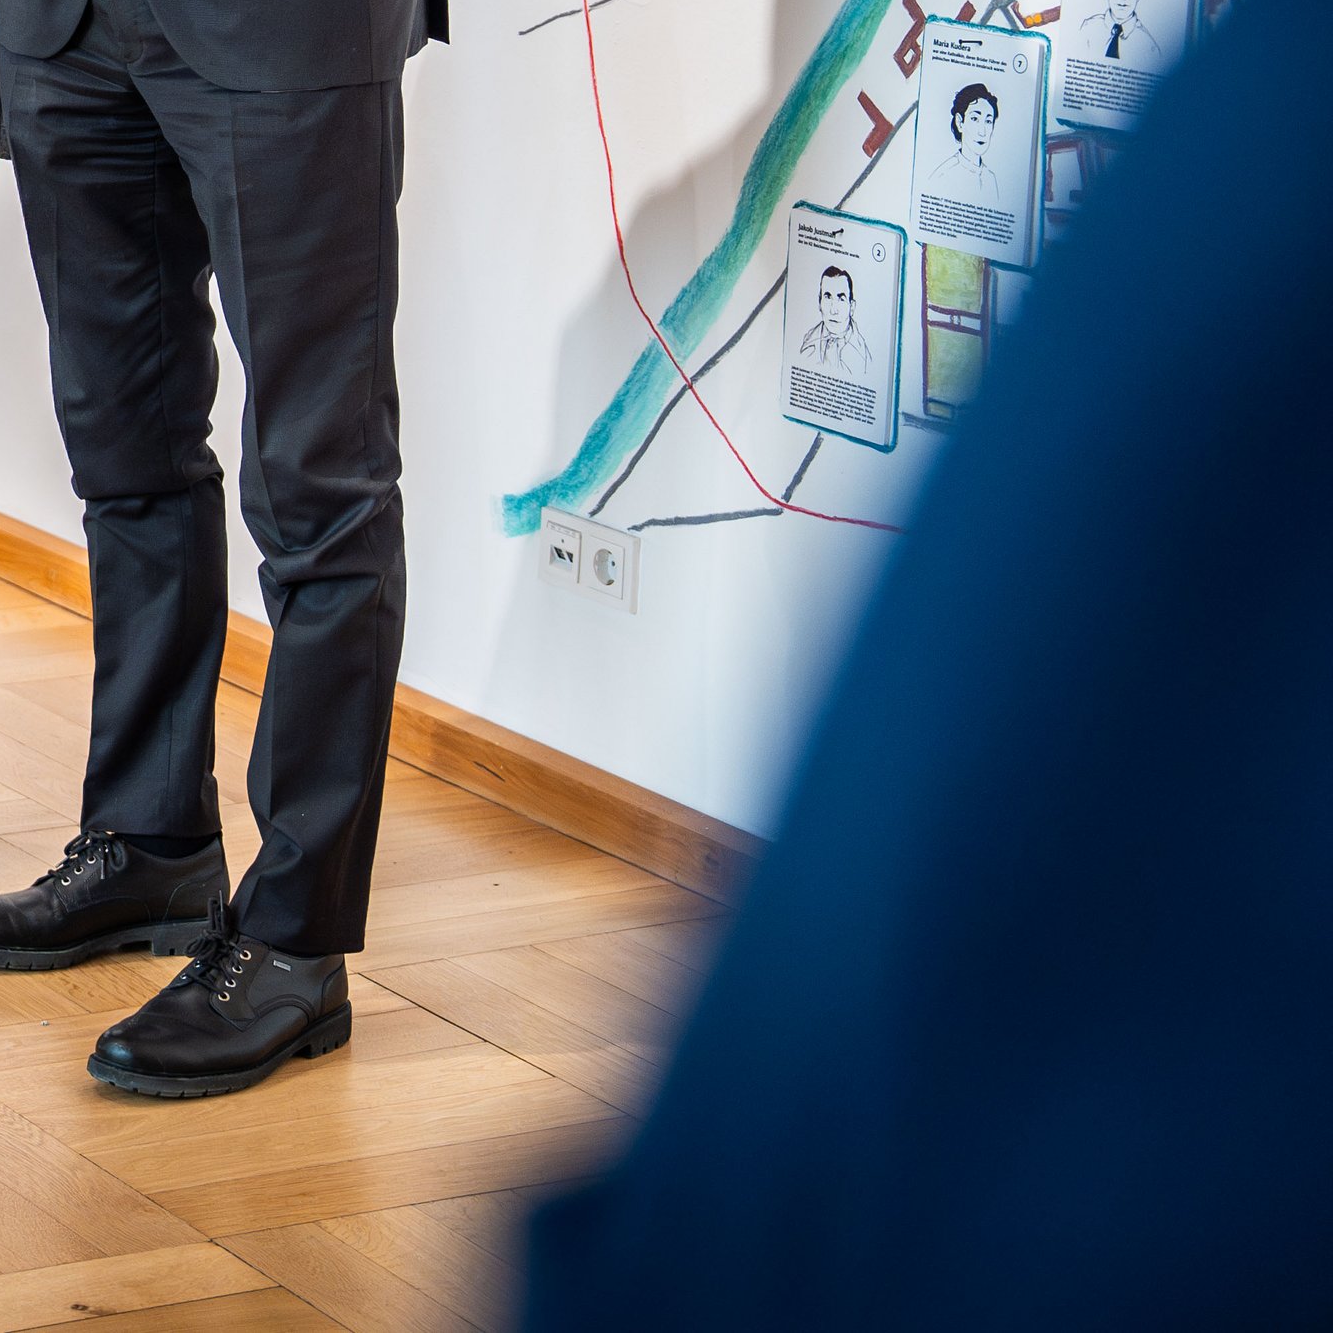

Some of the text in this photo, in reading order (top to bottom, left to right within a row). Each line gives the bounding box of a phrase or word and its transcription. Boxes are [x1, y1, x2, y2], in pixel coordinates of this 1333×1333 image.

[933, 39, 971, 52] Maria Kudera
[798, 223, 813, 232] Jakob
